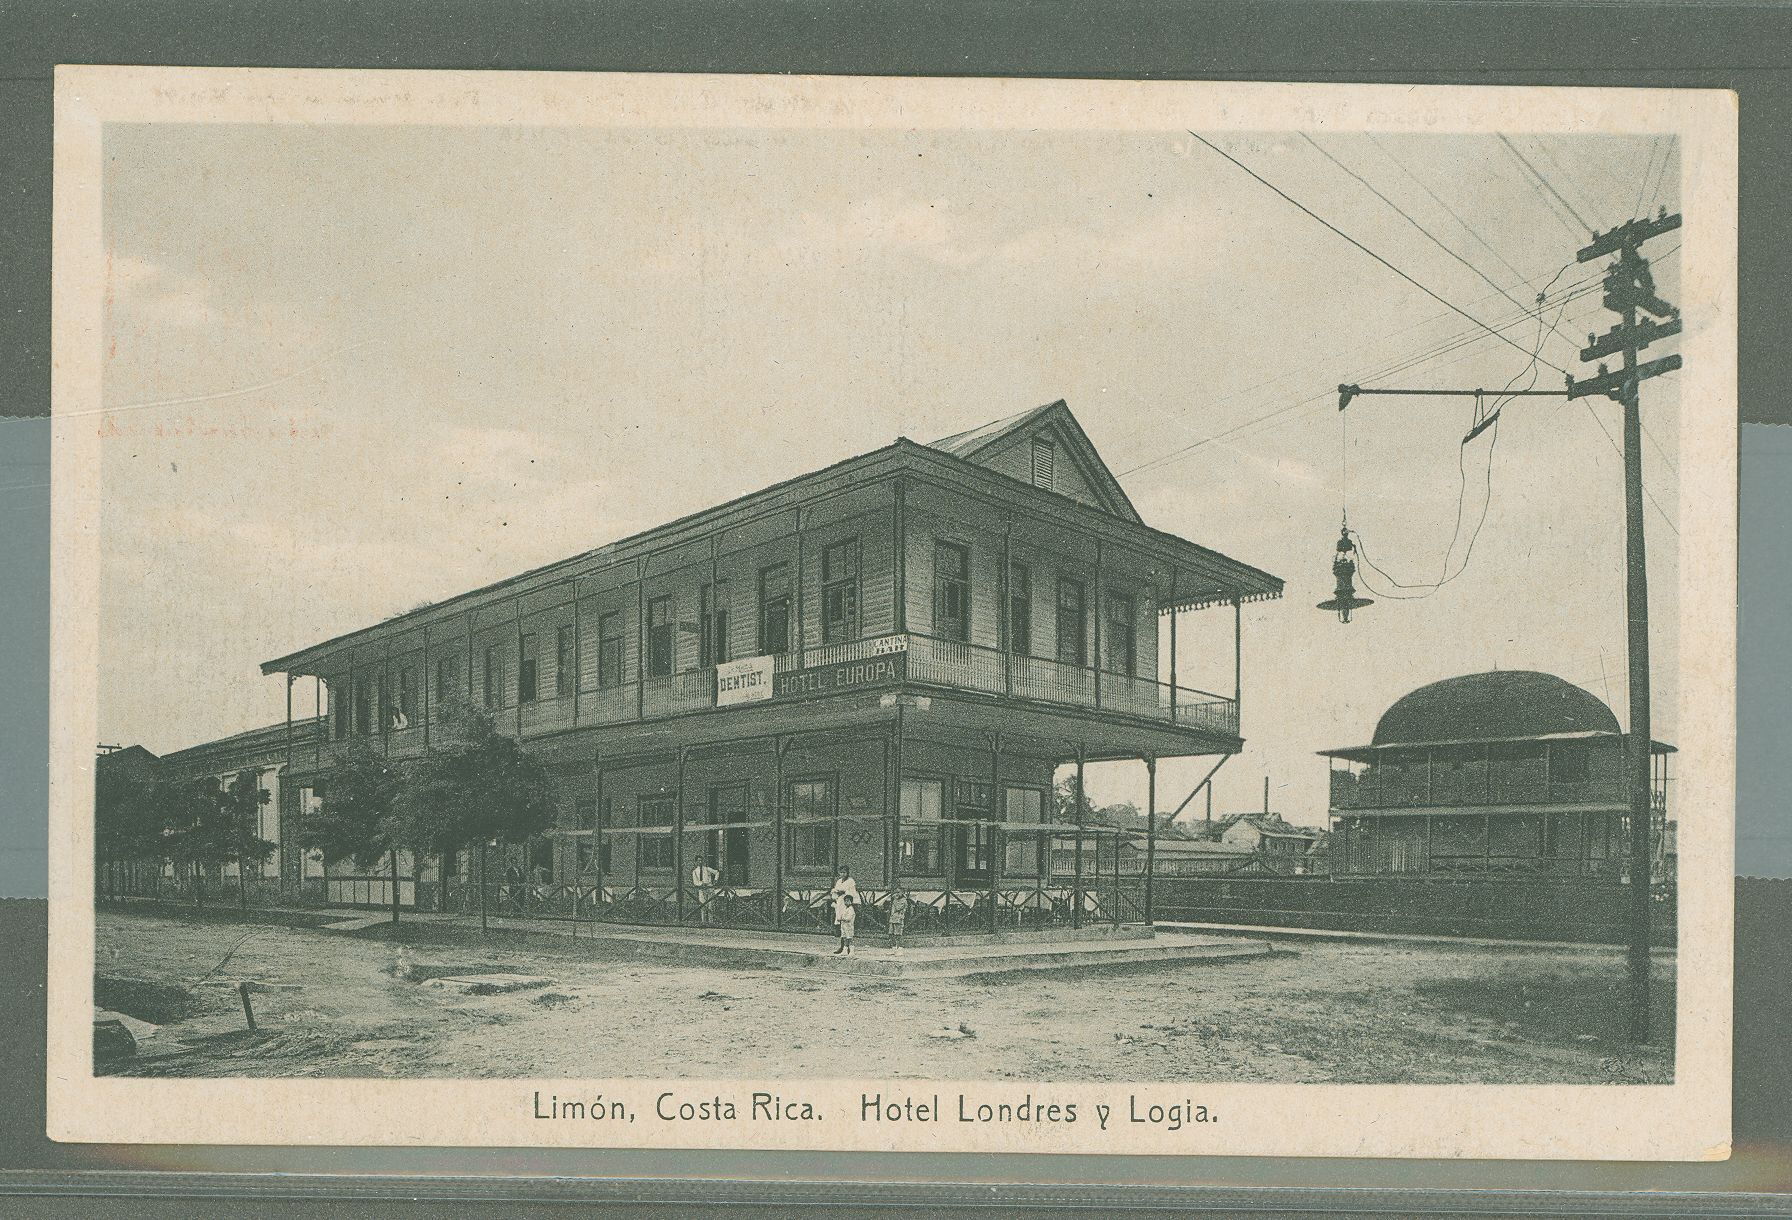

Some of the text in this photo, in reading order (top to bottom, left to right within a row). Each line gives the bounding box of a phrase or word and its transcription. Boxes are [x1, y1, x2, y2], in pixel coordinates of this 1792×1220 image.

[719, 670, 767, 692] DENTIST.
[781, 661, 896, 695] HOTEL EUROPA
